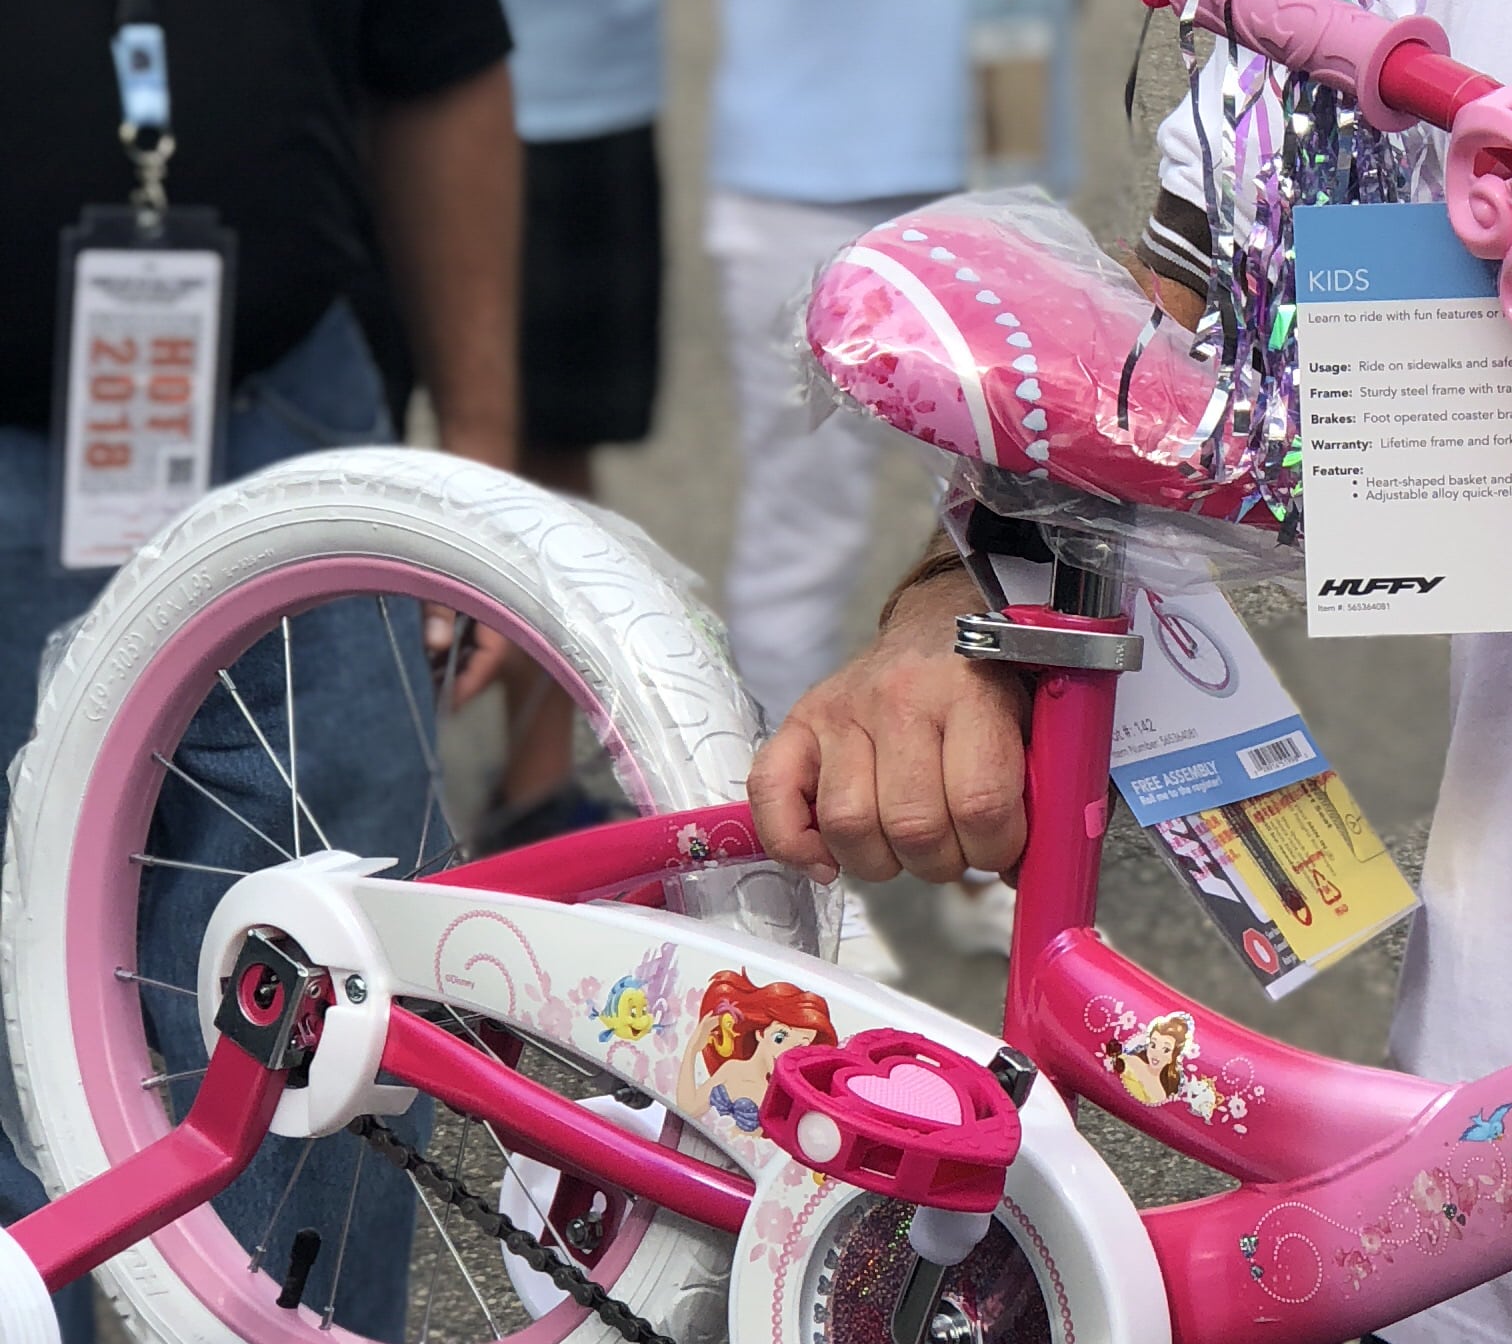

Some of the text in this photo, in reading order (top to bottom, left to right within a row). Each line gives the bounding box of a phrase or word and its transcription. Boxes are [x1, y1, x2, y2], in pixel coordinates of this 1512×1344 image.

[1309, 268, 1370, 292] KIDS
[1308, 312, 1341, 324] Learn
[1344, 313, 1356, 323] to
[1360, 311, 1383, 323] ride
[1386, 310, 1411, 322] with
[1414, 308, 1433, 320] fun
[1436, 307, 1484, 320] features
[1309, 362, 1352, 375] Usage:
[1359, 360, 1385, 372] Ride
[1388, 362, 1404, 371] on
[1407, 358, 1464, 371] sidewalks
[1466, 357, 1488, 369] and
[146, 338, 195, 441] HOT
[1310, 388, 1353, 399] Frame:
[1359, 386, 1398, 400] Sturdy
[1400, 384, 1429, 398] steel
[1432, 383, 1466, 396] frame
[1469, 383, 1493, 394] with
[84, 336, 138, 474] 2018
[1311, 413, 1357, 425] Brakes:
[1363, 412, 1391, 424] Foot
[1393, 410, 1448, 426] operated
[1451, 409, 1494, 422] coaster
[1311, 439, 1373, 453] Warranty:
[1380, 437, 1427, 449] Lifetime
[1430, 436, 1464, 448] frame
[1467, 435, 1490, 446] and
[1312, 466, 1364, 477] Feature:
[1366, 475, 1446, 489] Heart-shaped
[1448, 474, 1488, 486] basket
[1490, 473, 1512, 485] and
[1366, 488, 1429, 503] Adjustable
[1431, 488, 1460, 502] alloy
[1318, 576, 1447, 597] HUFFY
[1318, 604, 1336, 612] Item
[1136, 718, 1157, 734] 142
[1131, 760, 1218, 795] FREE ASSEMBLY
[1157, 791, 1169, 802] me
[1168, 788, 1178, 799] to
[1178, 784, 1192, 797] the
